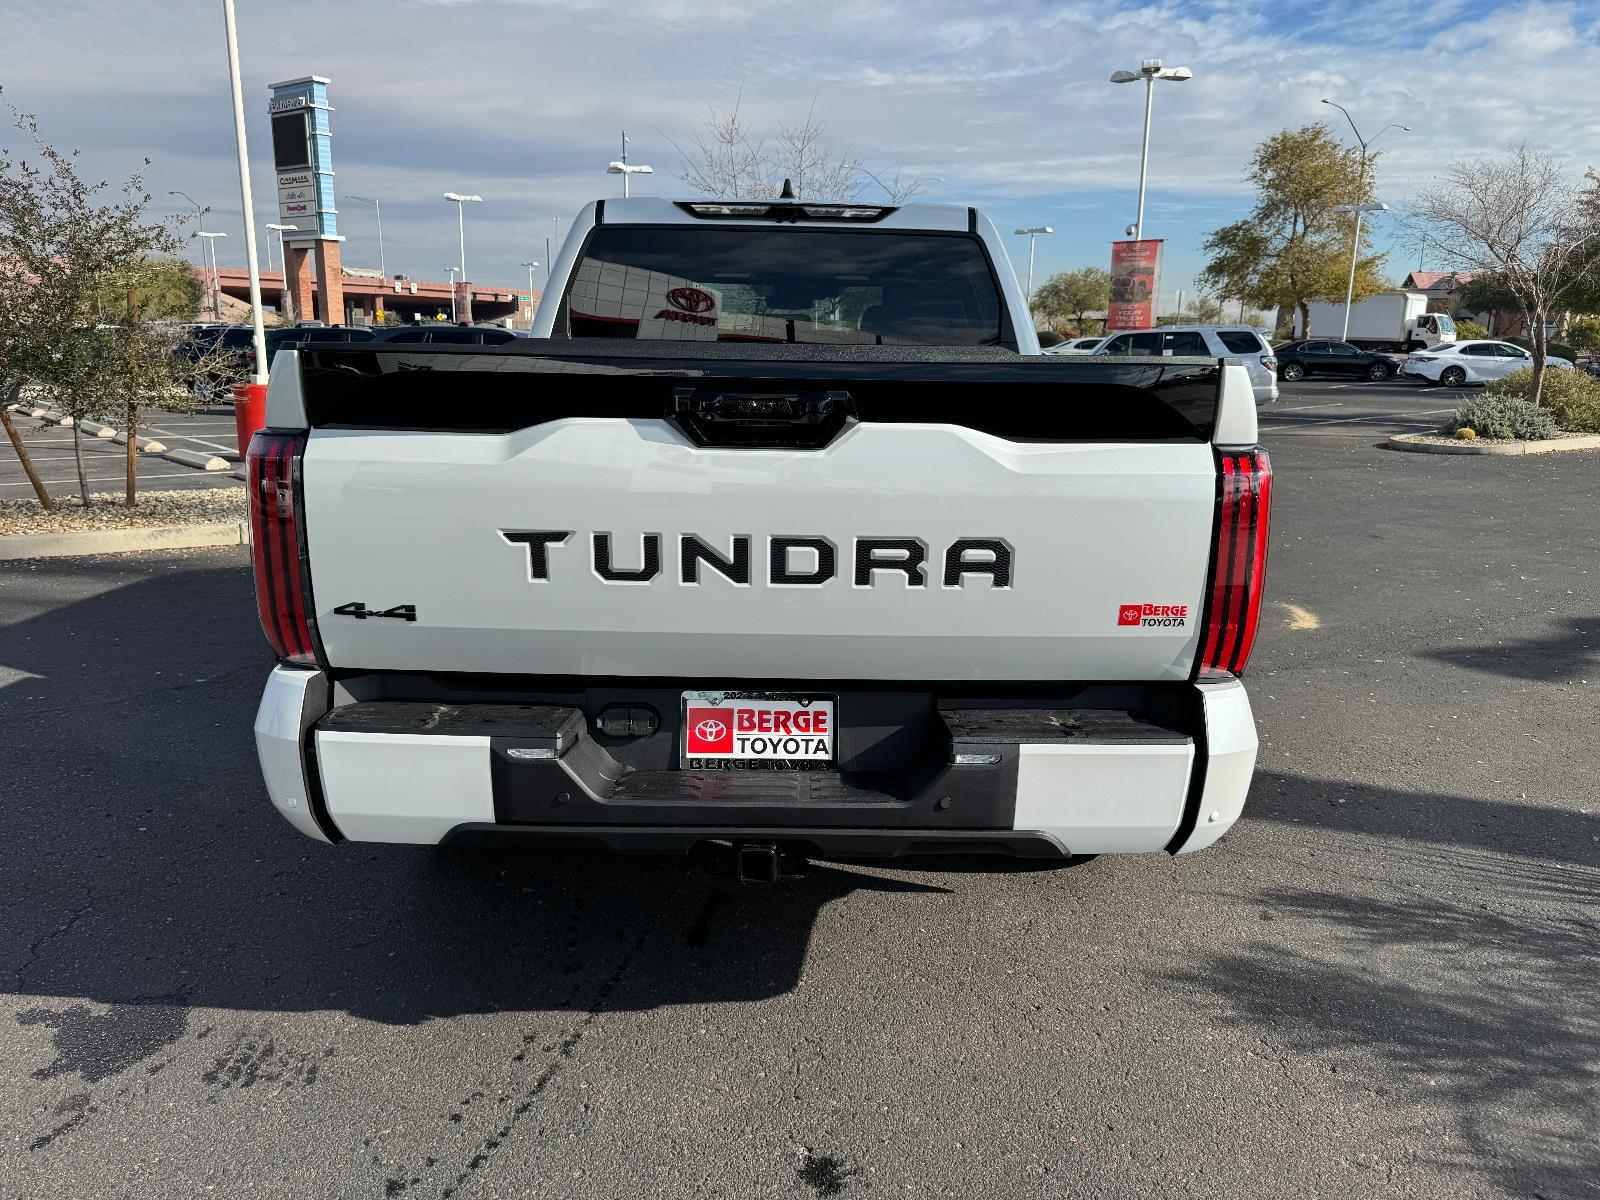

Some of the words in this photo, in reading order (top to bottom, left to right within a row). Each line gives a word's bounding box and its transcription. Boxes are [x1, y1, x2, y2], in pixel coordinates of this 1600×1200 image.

[496, 528, 1016, 590] TUNDRA
[1142, 604, 1188, 617] BERGE
[1142, 619, 1185, 627] TOYOTA
[737, 709, 828, 735] BERGE
[737, 738, 829, 755] TOYOTA
[690, 759, 760, 770] BERGE
[768, 759, 830, 771] TOYOTA
